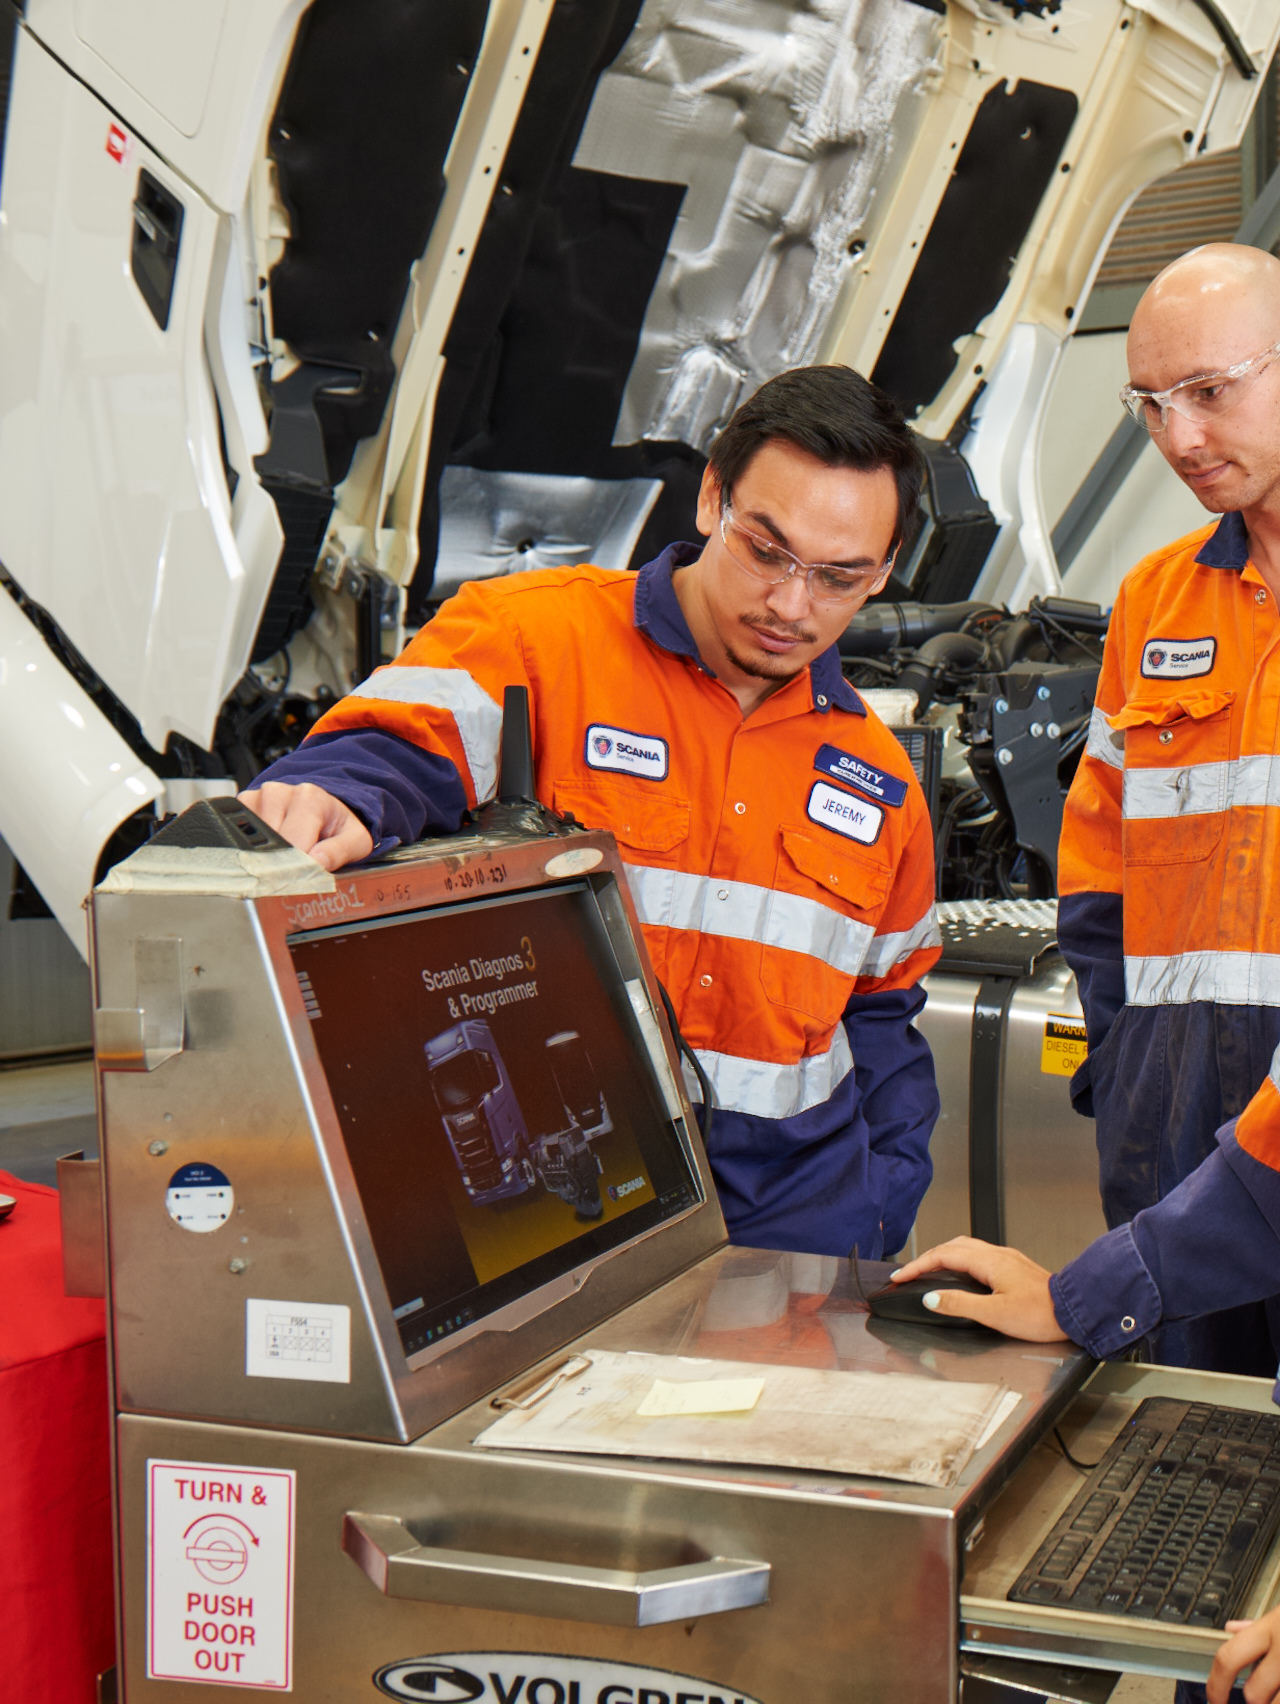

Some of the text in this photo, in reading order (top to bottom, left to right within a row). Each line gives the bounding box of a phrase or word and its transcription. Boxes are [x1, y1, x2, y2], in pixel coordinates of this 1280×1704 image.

[1171, 650, 1210, 662] SCANIA
[616, 742, 660, 762] SCANIA
[838, 756, 884, 785] SAFETY
[822, 799, 867, 825] JEREMY
[421, 936, 536, 992] Scania Diagnos 3
[447, 980, 539, 1019] & Programmer
[1053, 1023, 1088, 1038] WARN
[1046, 1040, 1079, 1055] DIESEL
[616, 1175, 646, 1198] SCANIA
[174, 1479, 268, 1506] TURN &
[186, 1592, 254, 1618] PUSH
[184, 1620, 256, 1646] DOOR
[194, 1649, 246, 1673] OUT
